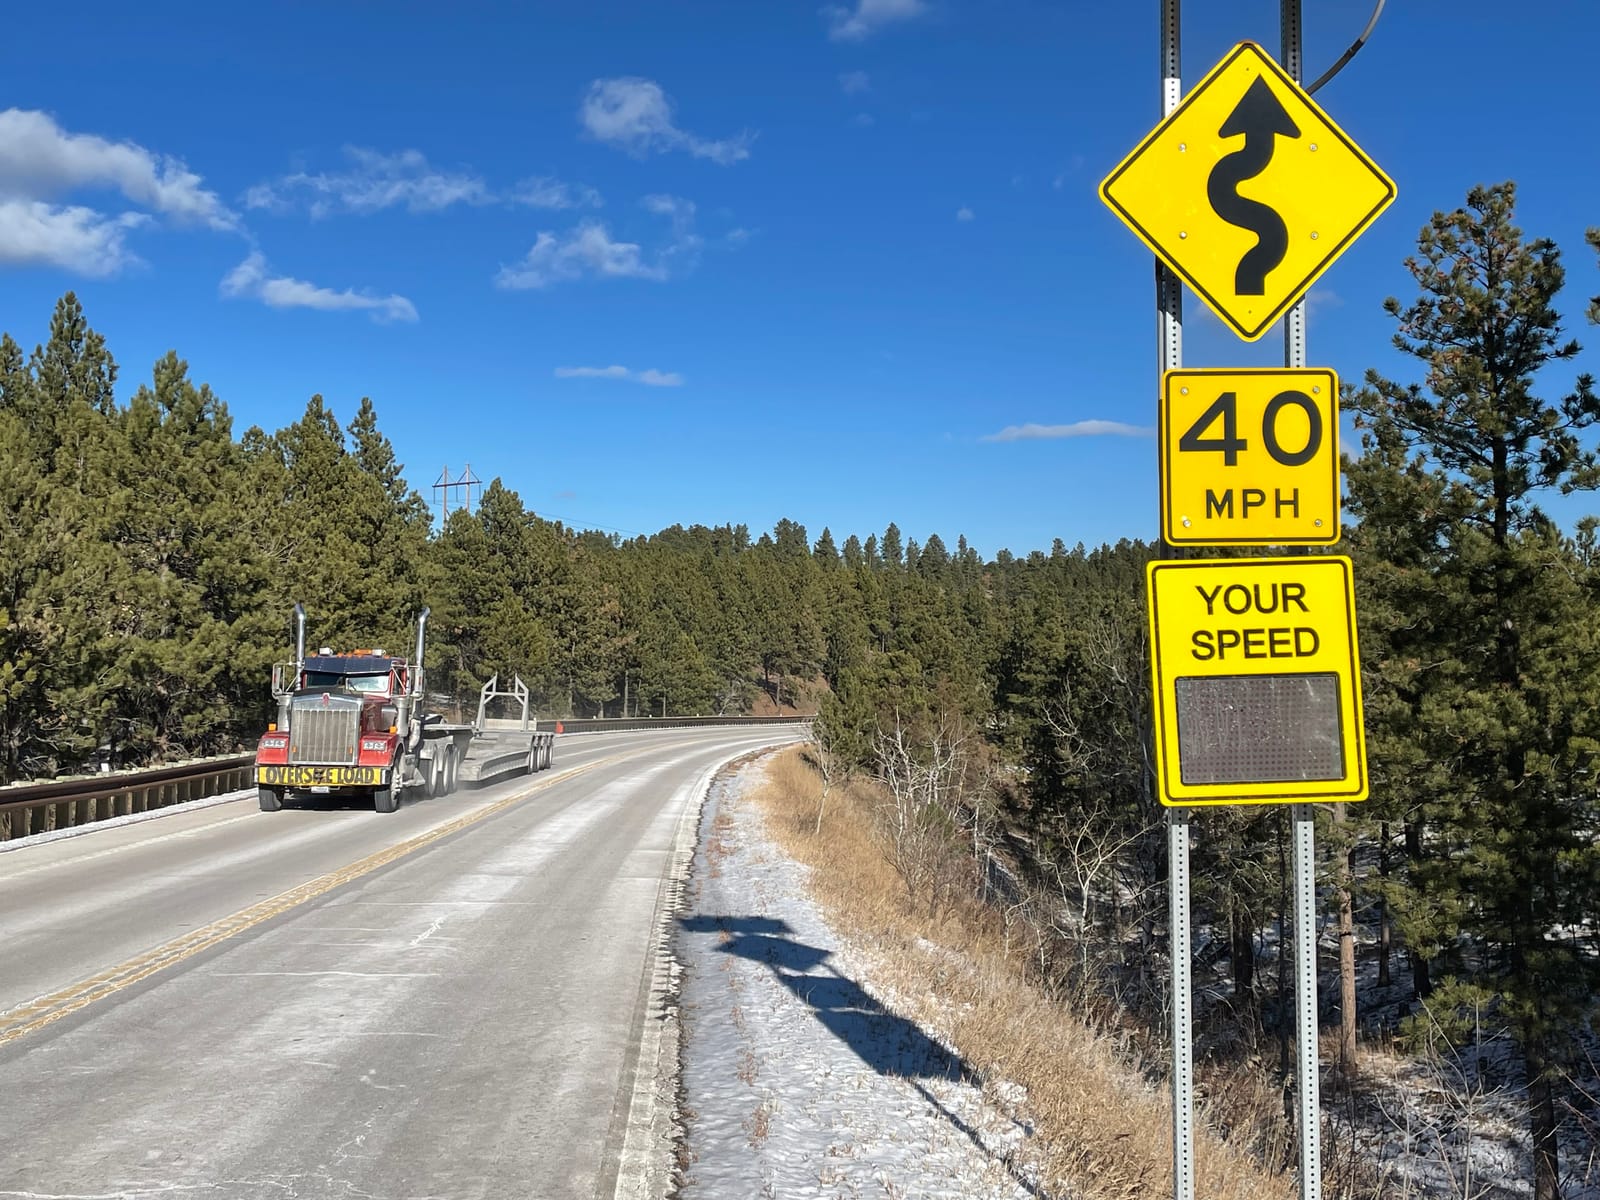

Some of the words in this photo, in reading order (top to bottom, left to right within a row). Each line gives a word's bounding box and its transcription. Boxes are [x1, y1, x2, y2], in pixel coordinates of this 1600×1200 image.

[1179, 390, 1322, 466] 40
[1205, 489, 1299, 518] MPH
[1195, 582, 1309, 615] YOUR
[1191, 627, 1320, 660] SPEED
[337, 768, 374, 784] LOAD
